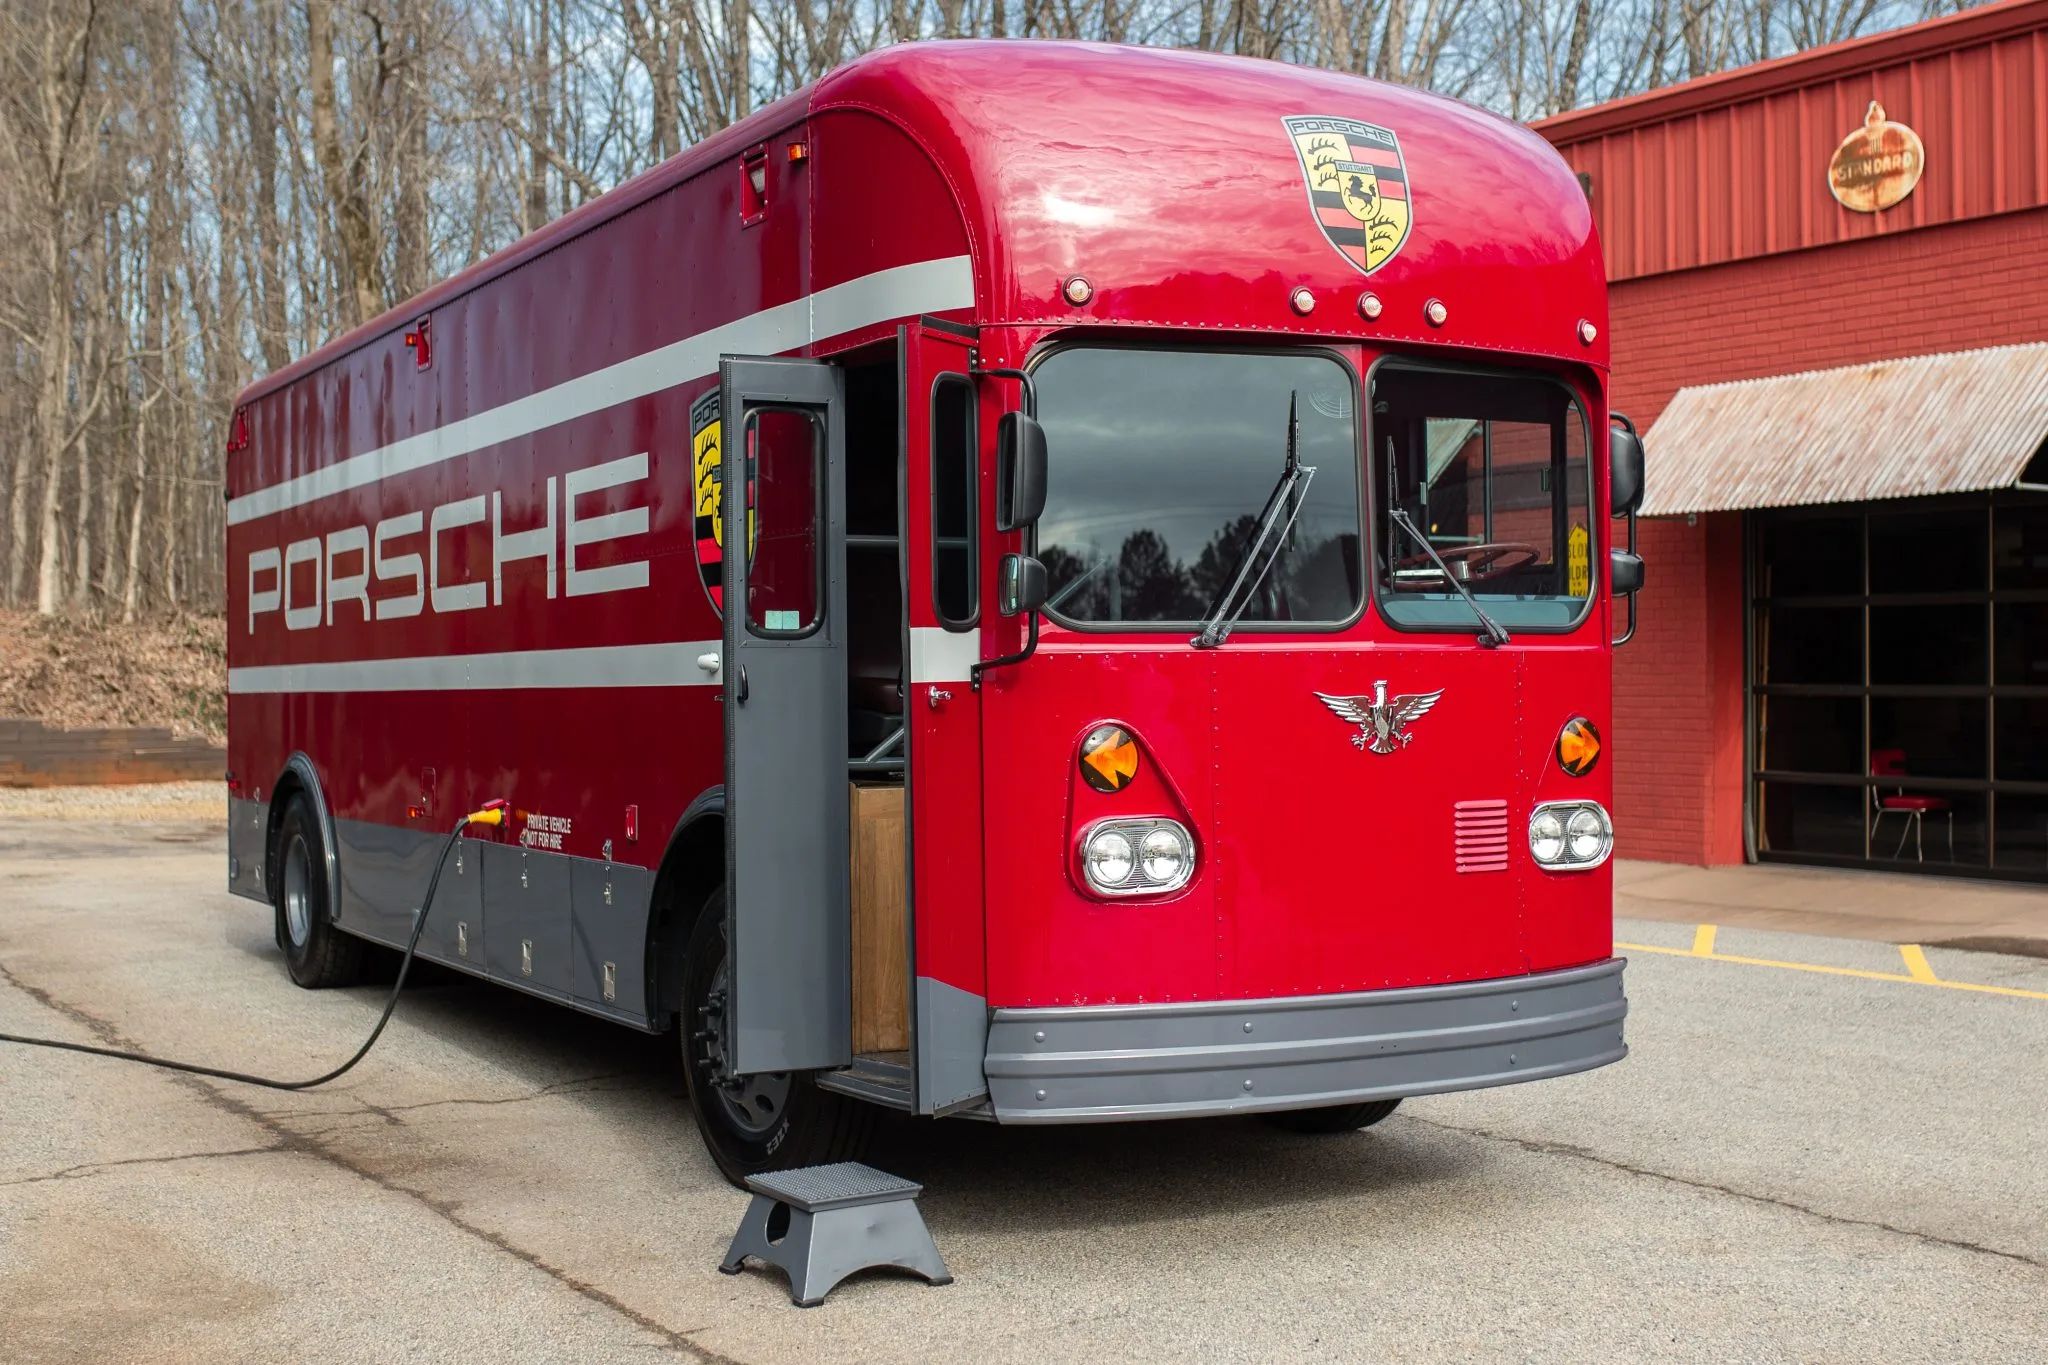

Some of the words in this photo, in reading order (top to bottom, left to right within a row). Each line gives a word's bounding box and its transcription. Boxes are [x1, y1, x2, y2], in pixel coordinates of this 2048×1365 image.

[1291, 121, 1391, 143] PORSCHE
[249, 452, 649, 635] PORSCHE
[527, 814, 549, 831] PRIVATE
[550, 817, 571, 834] VEHICLE
[527, 832, 538, 846] NOT
[538, 833, 549, 848] FOR
[550, 834, 562, 849] HIRE
